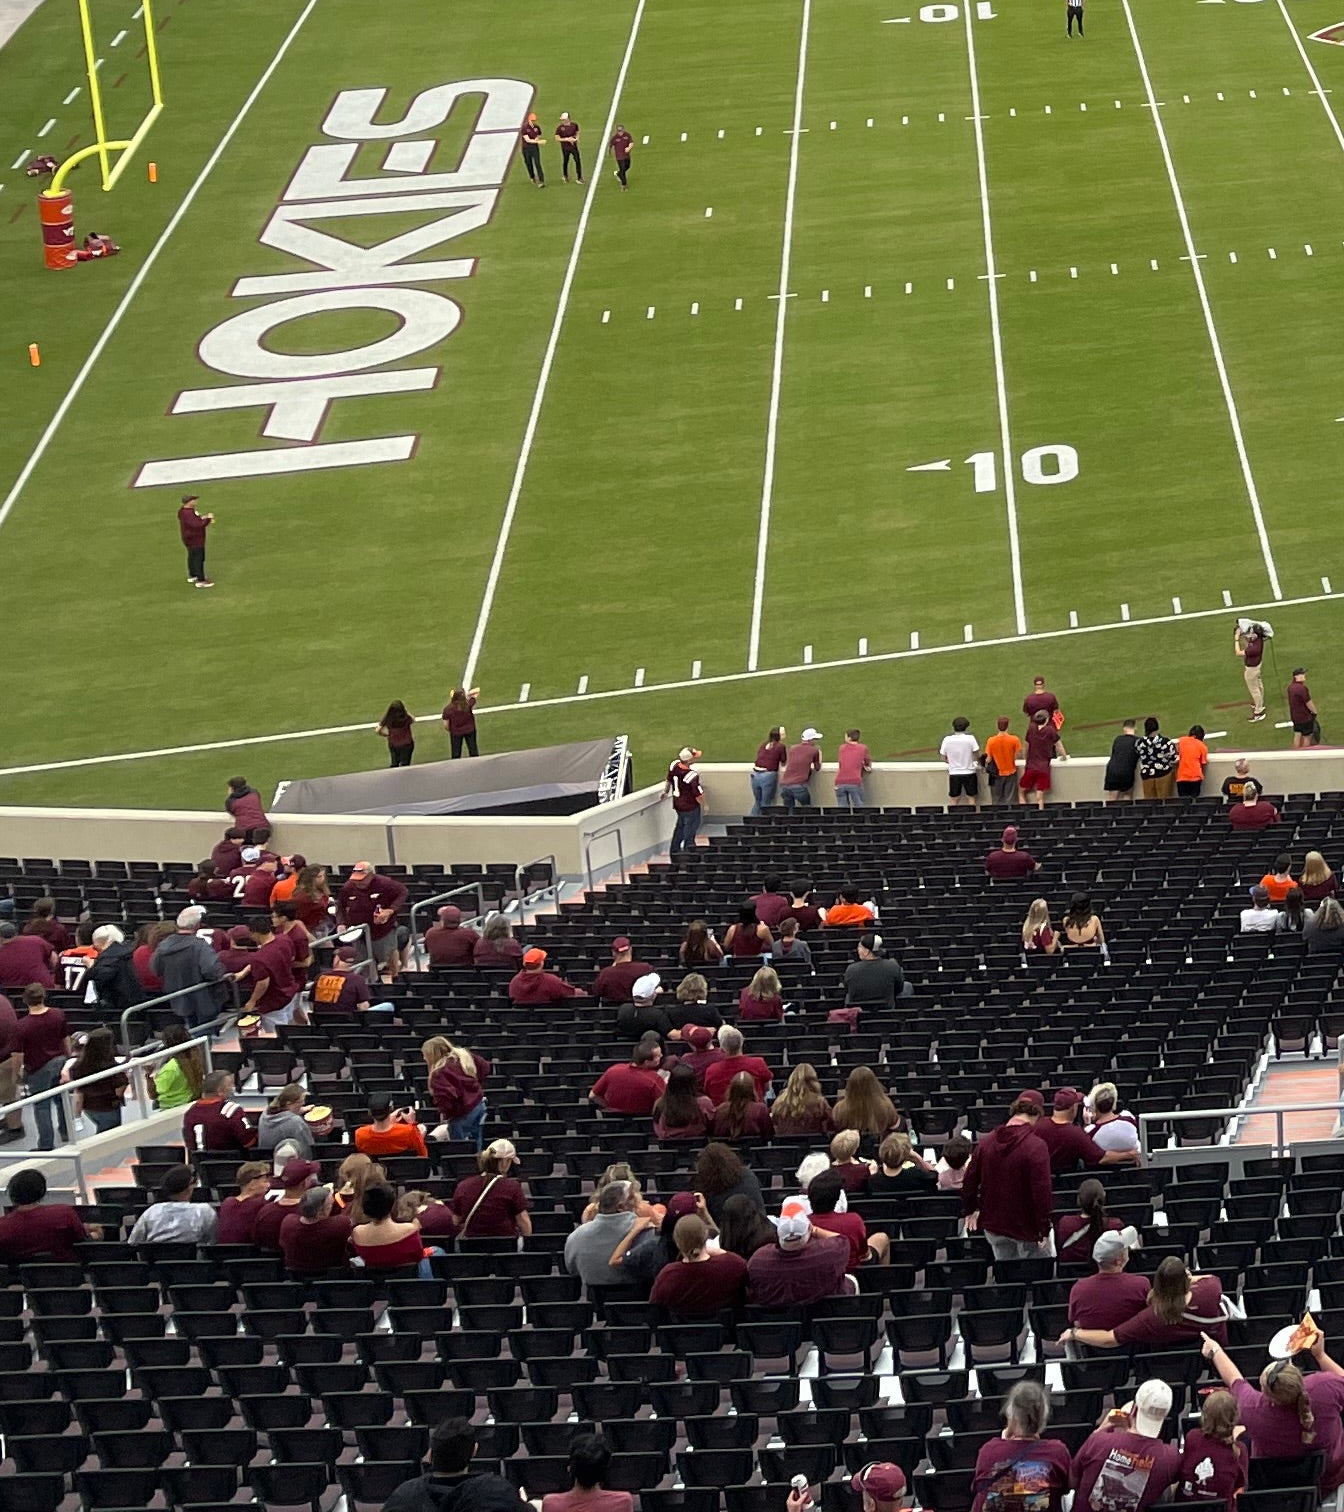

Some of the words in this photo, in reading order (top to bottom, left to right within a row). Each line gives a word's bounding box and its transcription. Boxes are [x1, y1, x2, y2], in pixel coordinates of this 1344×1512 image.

[130, 76, 537, 488] HOKIES
[964, 443, 1081, 494] 10
[63, 966, 87, 991] 17
